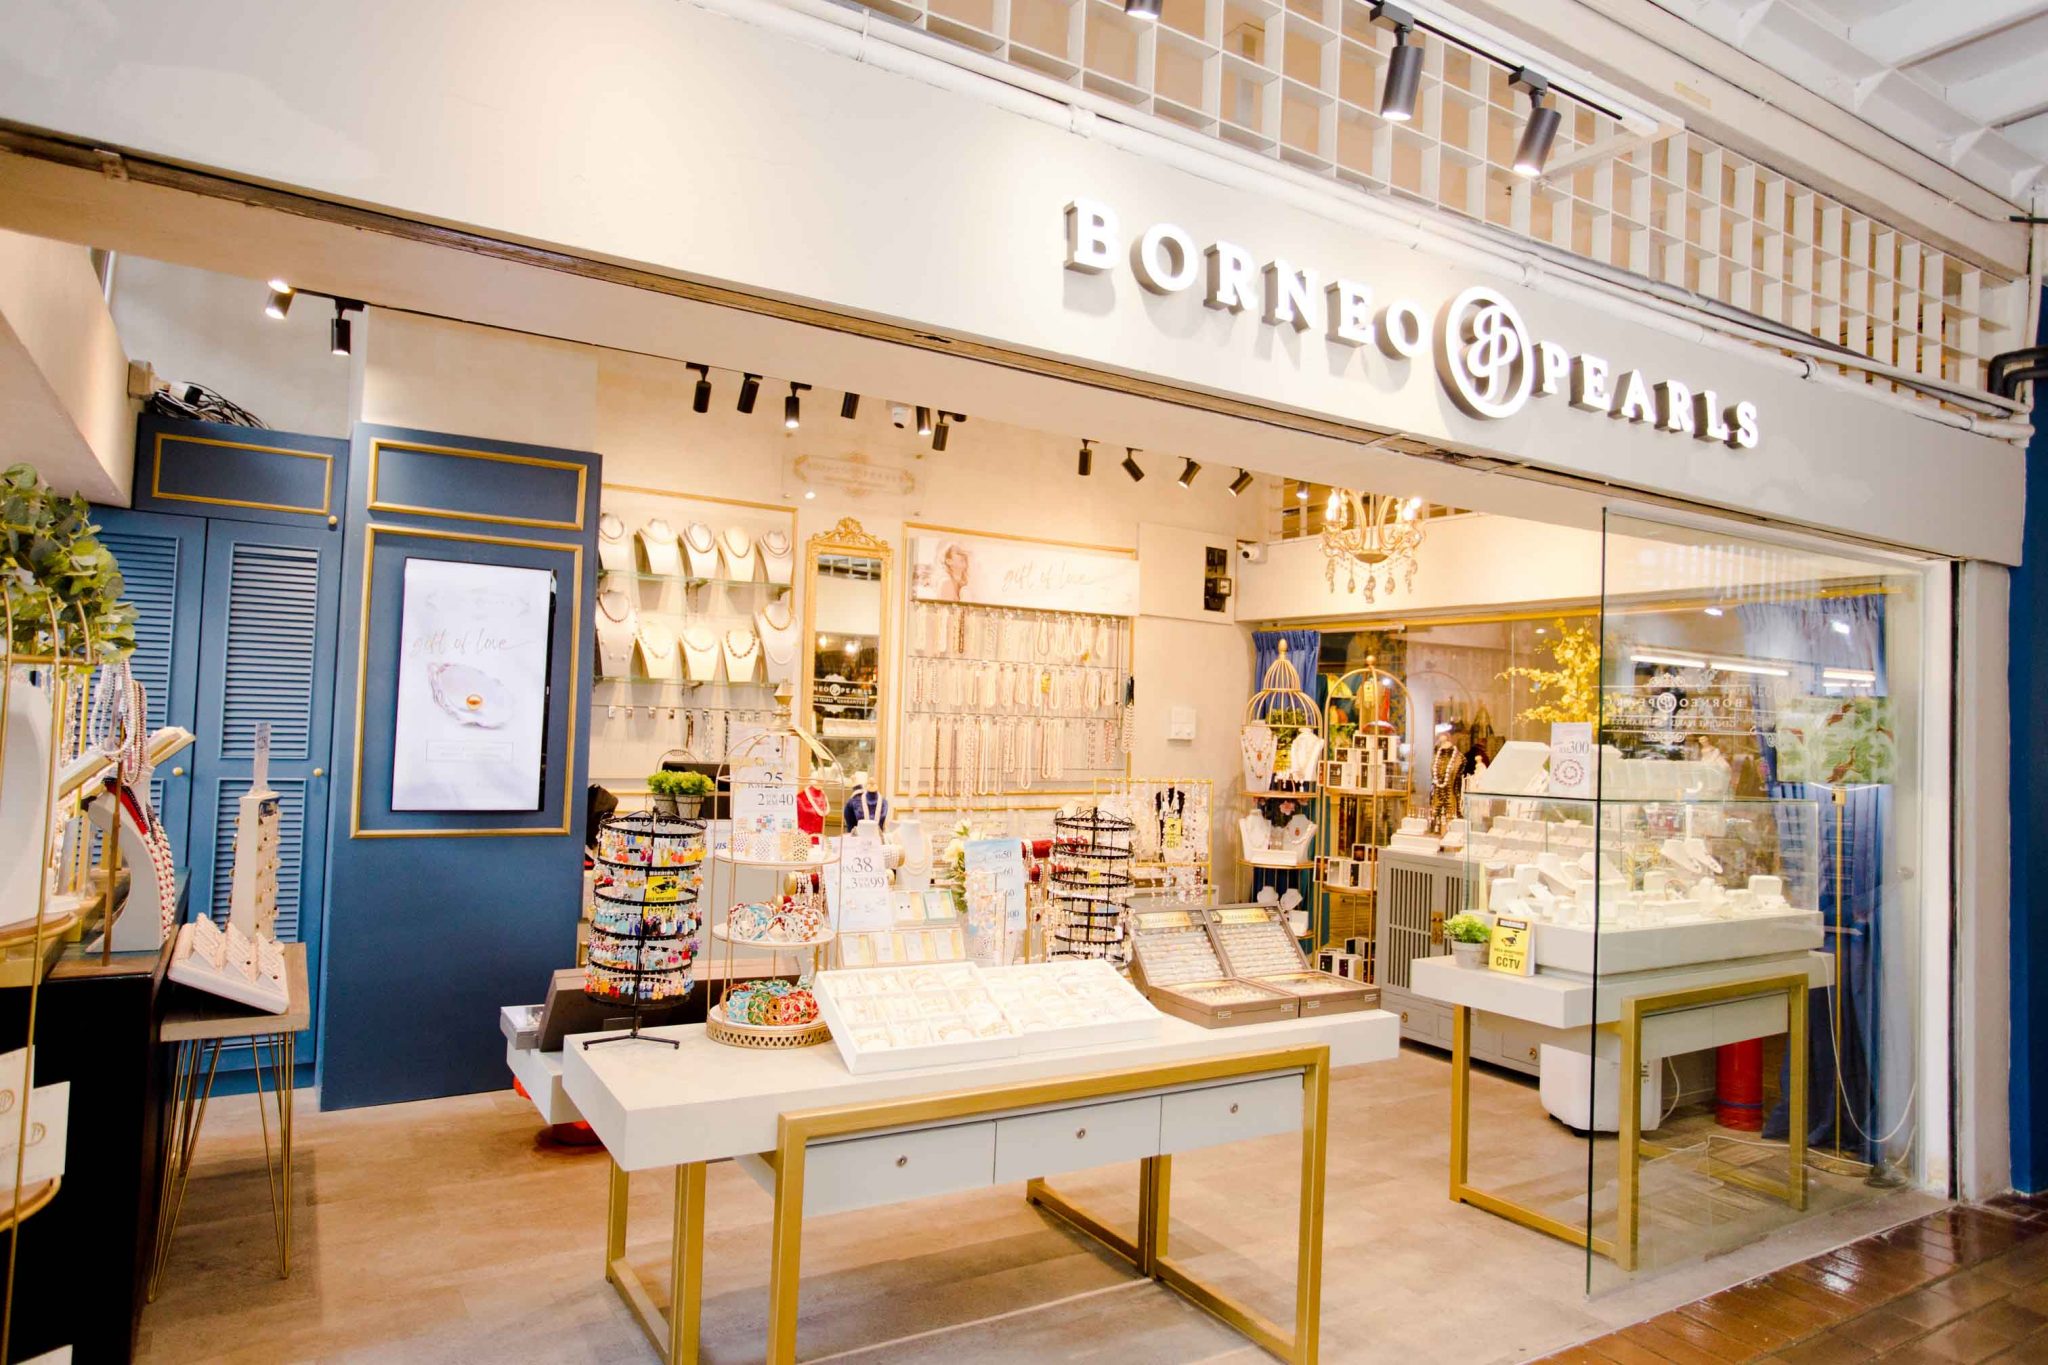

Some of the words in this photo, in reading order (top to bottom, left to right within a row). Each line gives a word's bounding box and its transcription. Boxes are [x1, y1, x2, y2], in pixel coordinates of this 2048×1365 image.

[1063, 199, 1431, 360] BORNEO
[1531, 339, 1759, 450] PEARLS
[453, 630, 469, 655] of
[1495, 956, 1521, 970] CCTV
